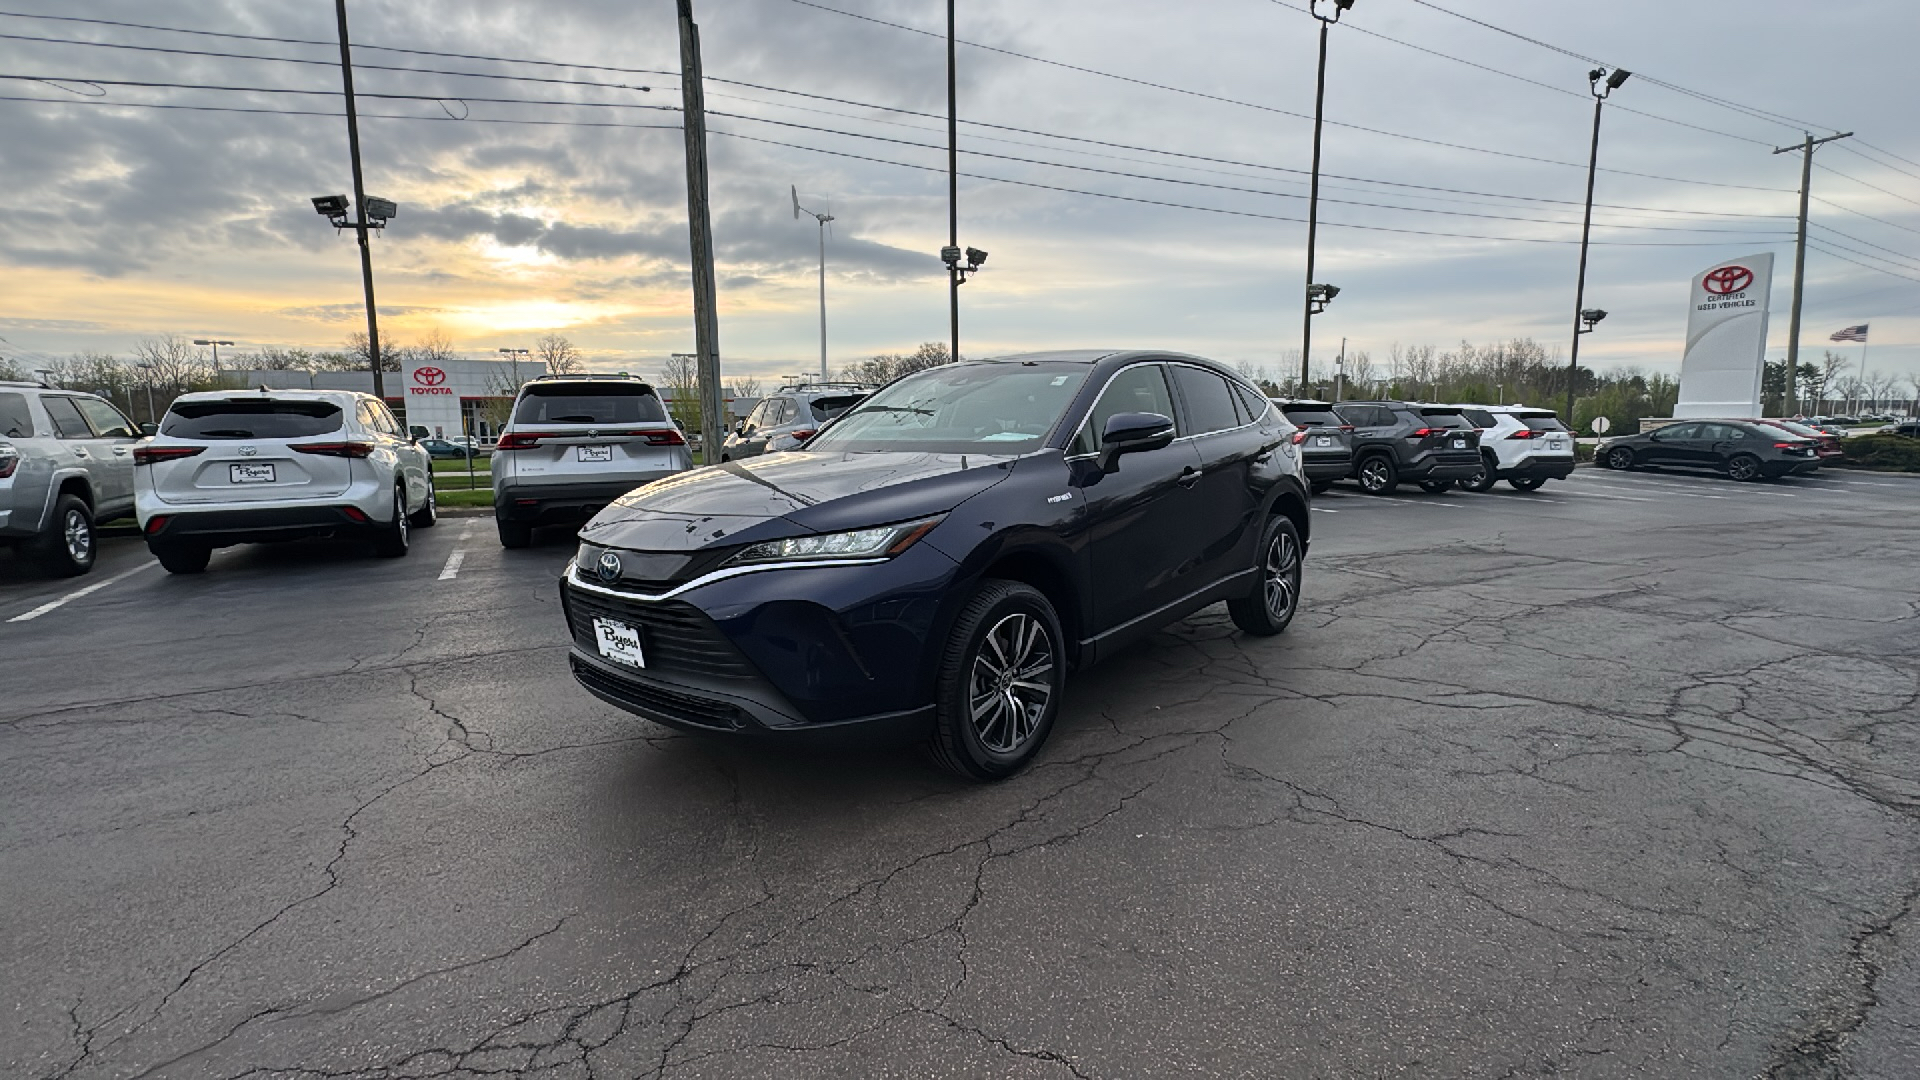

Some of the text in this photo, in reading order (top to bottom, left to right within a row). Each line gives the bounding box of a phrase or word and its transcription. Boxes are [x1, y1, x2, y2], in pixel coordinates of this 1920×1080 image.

[1707, 292, 1746, 302] CERTIFIED
[1697, 299, 1756, 311] USED VEHICLES
[409, 387, 453, 395] TOYOTA
[598, 625, 639, 650] Byers
